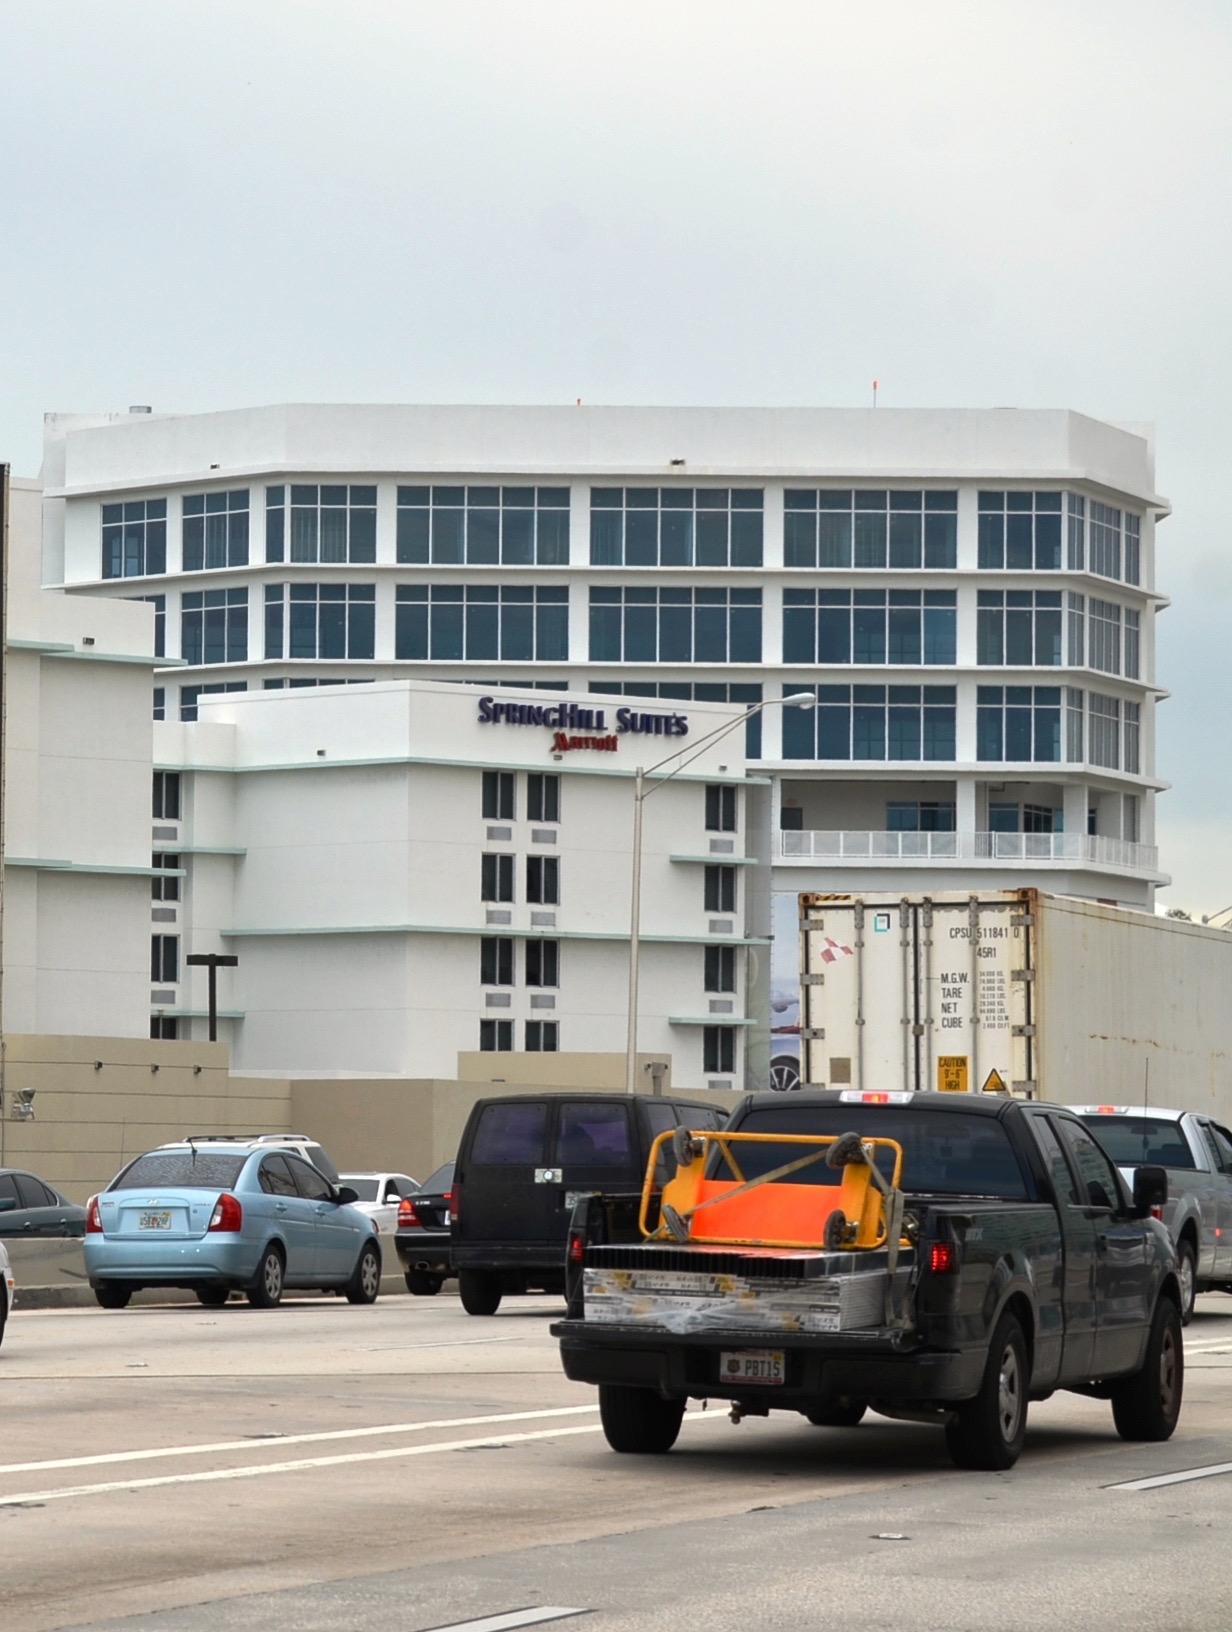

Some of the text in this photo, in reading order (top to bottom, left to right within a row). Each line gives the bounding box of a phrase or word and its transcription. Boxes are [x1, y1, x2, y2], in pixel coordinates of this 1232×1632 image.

[976, 927, 1009, 939] 511841
[976, 947, 997, 959] 45R1
[941, 987, 963, 999] TARE
[941, 1002, 958, 1014] NET
[941, 1016, 963, 1029] CUBE
[938, 1057, 966, 1068] CAUTION
[945, 1080, 960, 1091] HIGH
